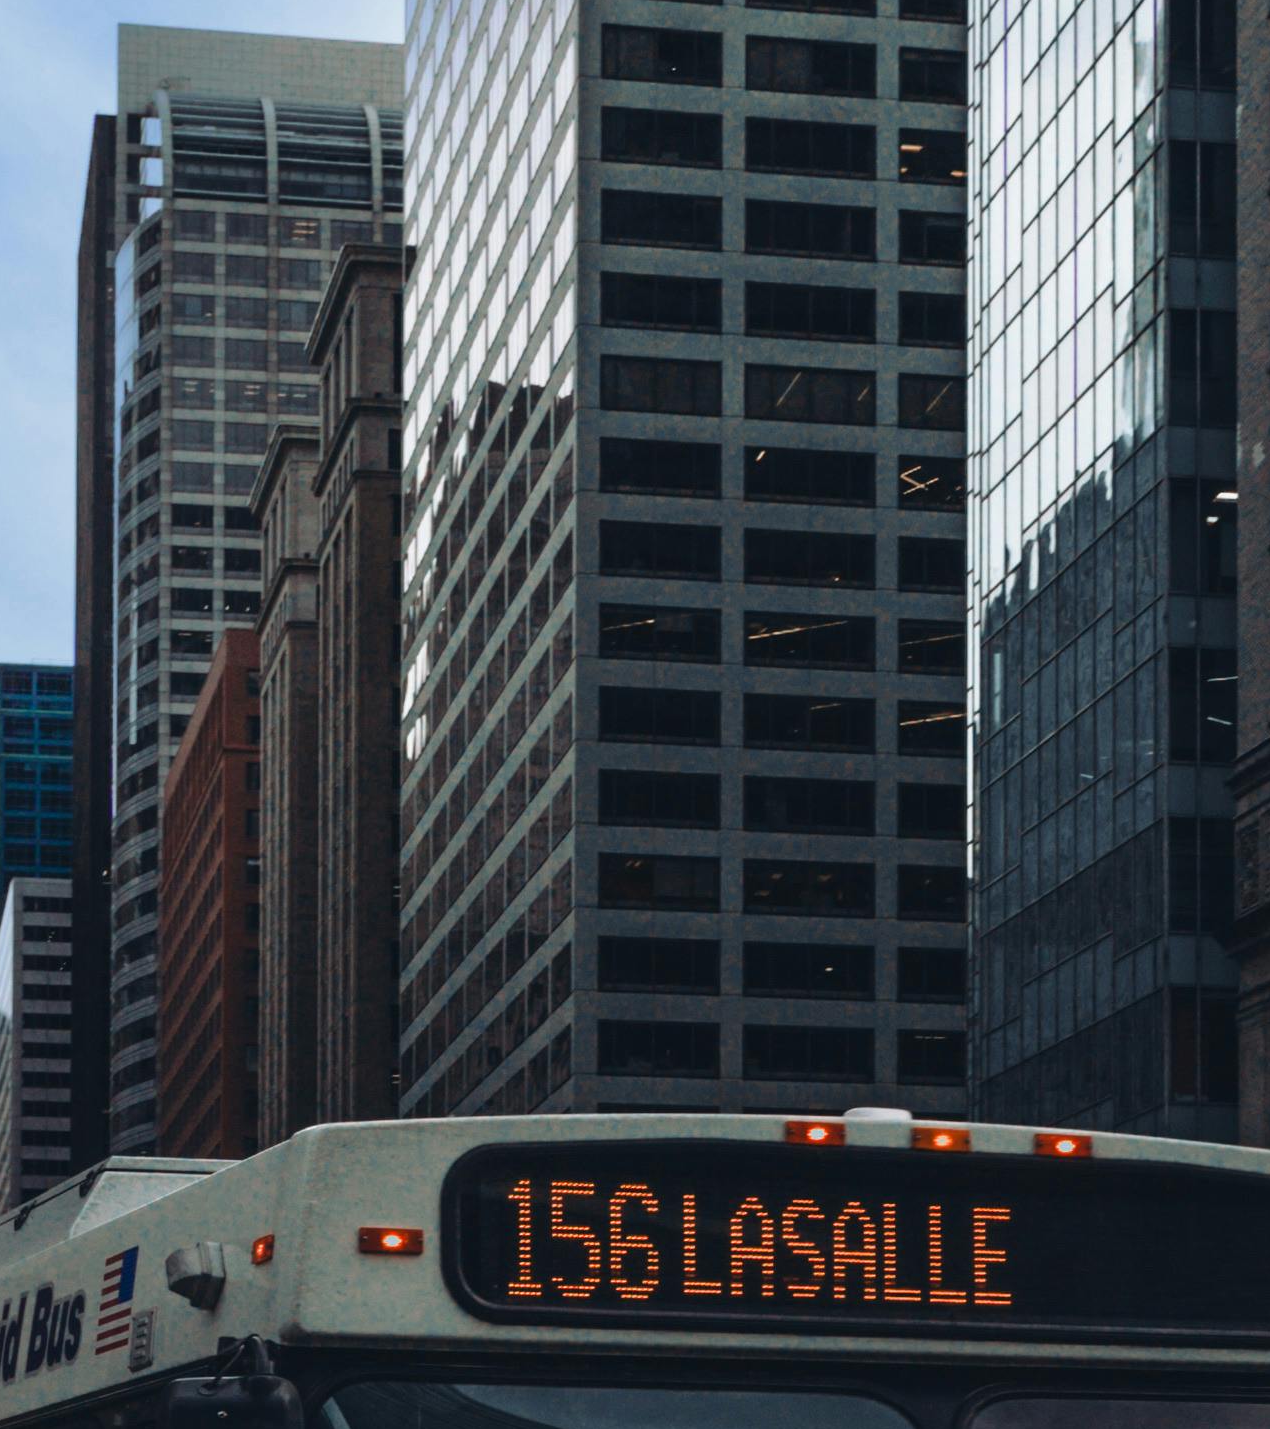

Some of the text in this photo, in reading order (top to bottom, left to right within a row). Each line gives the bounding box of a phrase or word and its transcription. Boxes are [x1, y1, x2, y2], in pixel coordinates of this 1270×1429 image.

[508, 1180, 1012, 1305] 156 LASALLE
[26, 1283, 86, 1375] Bus
